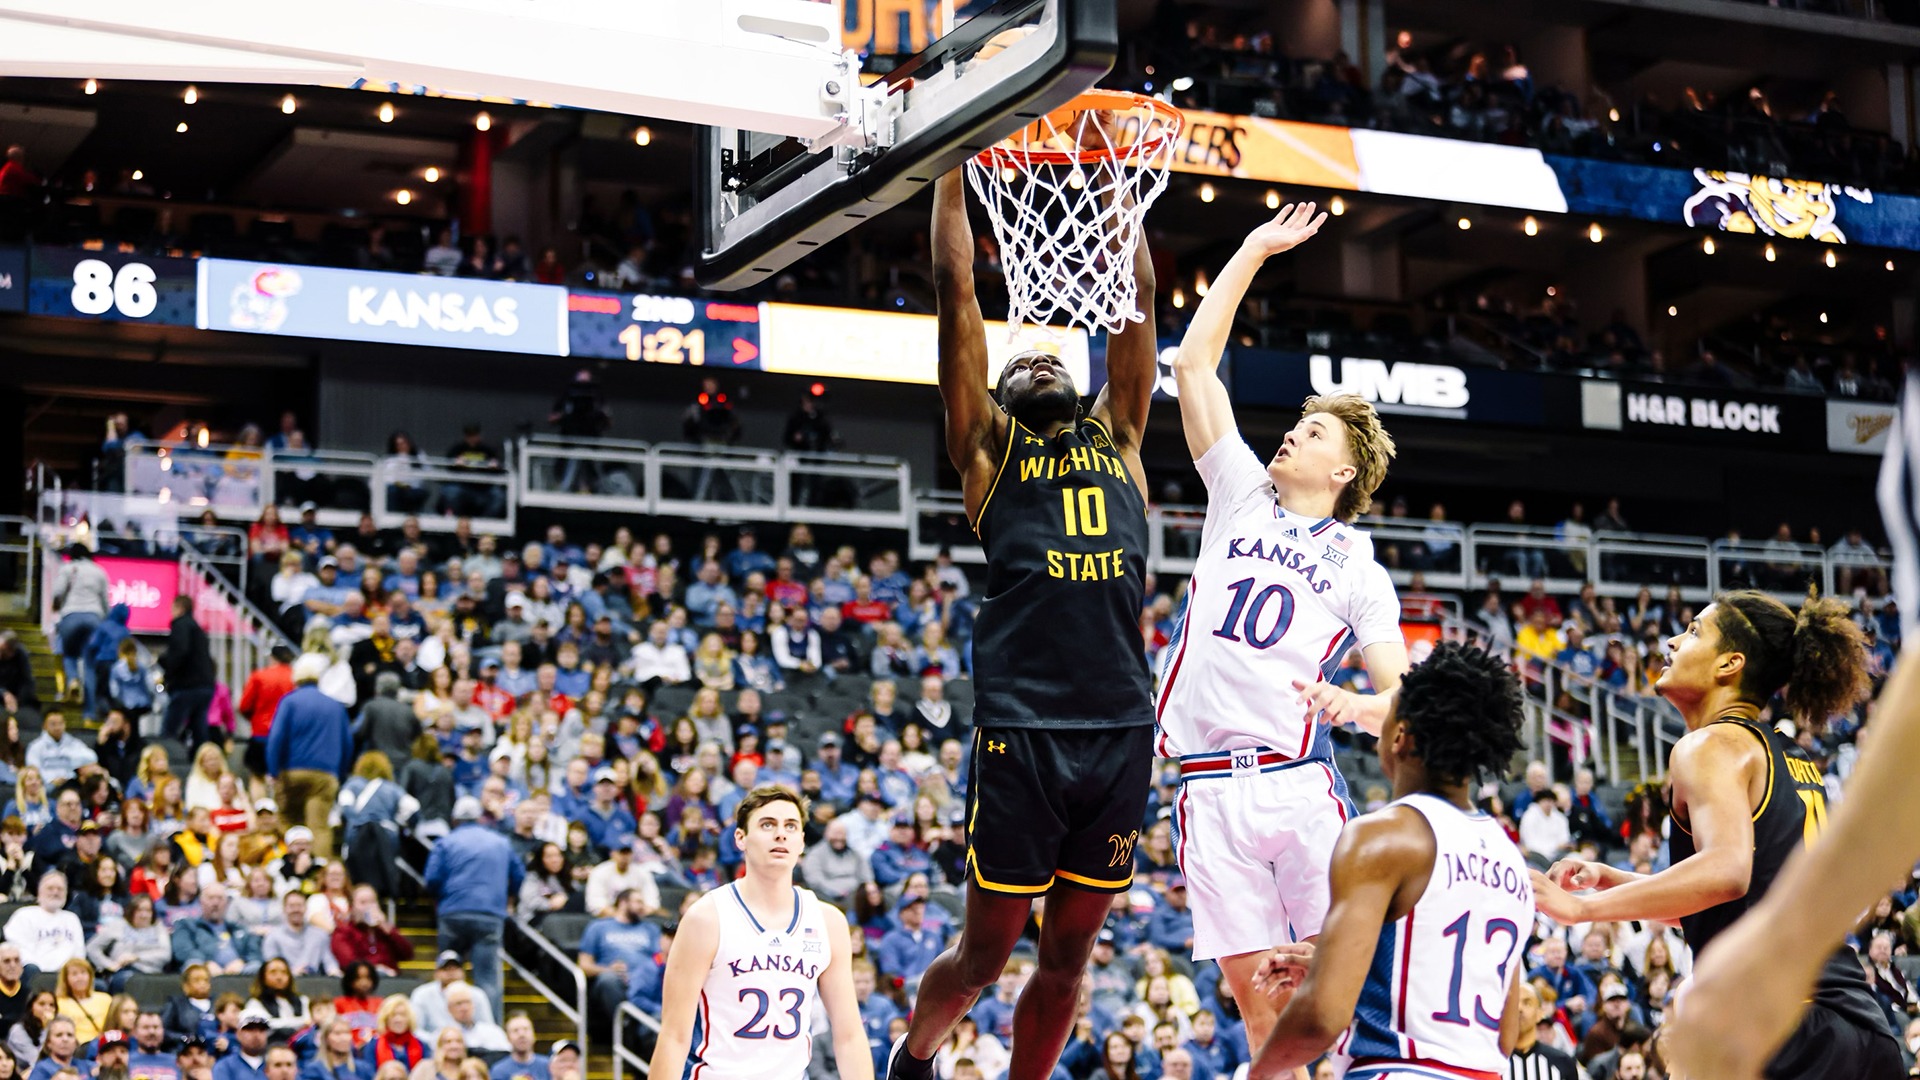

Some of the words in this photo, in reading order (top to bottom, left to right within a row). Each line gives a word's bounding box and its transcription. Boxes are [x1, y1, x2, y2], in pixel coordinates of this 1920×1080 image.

[71, 259, 158, 318] 86
[348, 285, 519, 336] KANSAS
[632, 294, 695, 324] 2ND
[619, 323, 705, 366] 1:21
[1309, 354, 1470, 408] UMB
[1627, 393, 1686, 426] H&R
[1690, 399, 1780, 434] BLOCK
[1020, 446, 1128, 484] WICHITA
[1062, 487, 1108, 536] 10
[1047, 548, 1125, 582] STATE
[1227, 537, 1332, 594] KANSAS
[109, 578, 161, 608] obile
[1212, 577, 1295, 649] 10
[1235, 754, 1254, 769] KU
[1443, 852, 1528, 903] JACKSON
[728, 954, 818, 980] KANSAS
[1431, 910, 1518, 1032] 13
[733, 988, 805, 1040] 23
